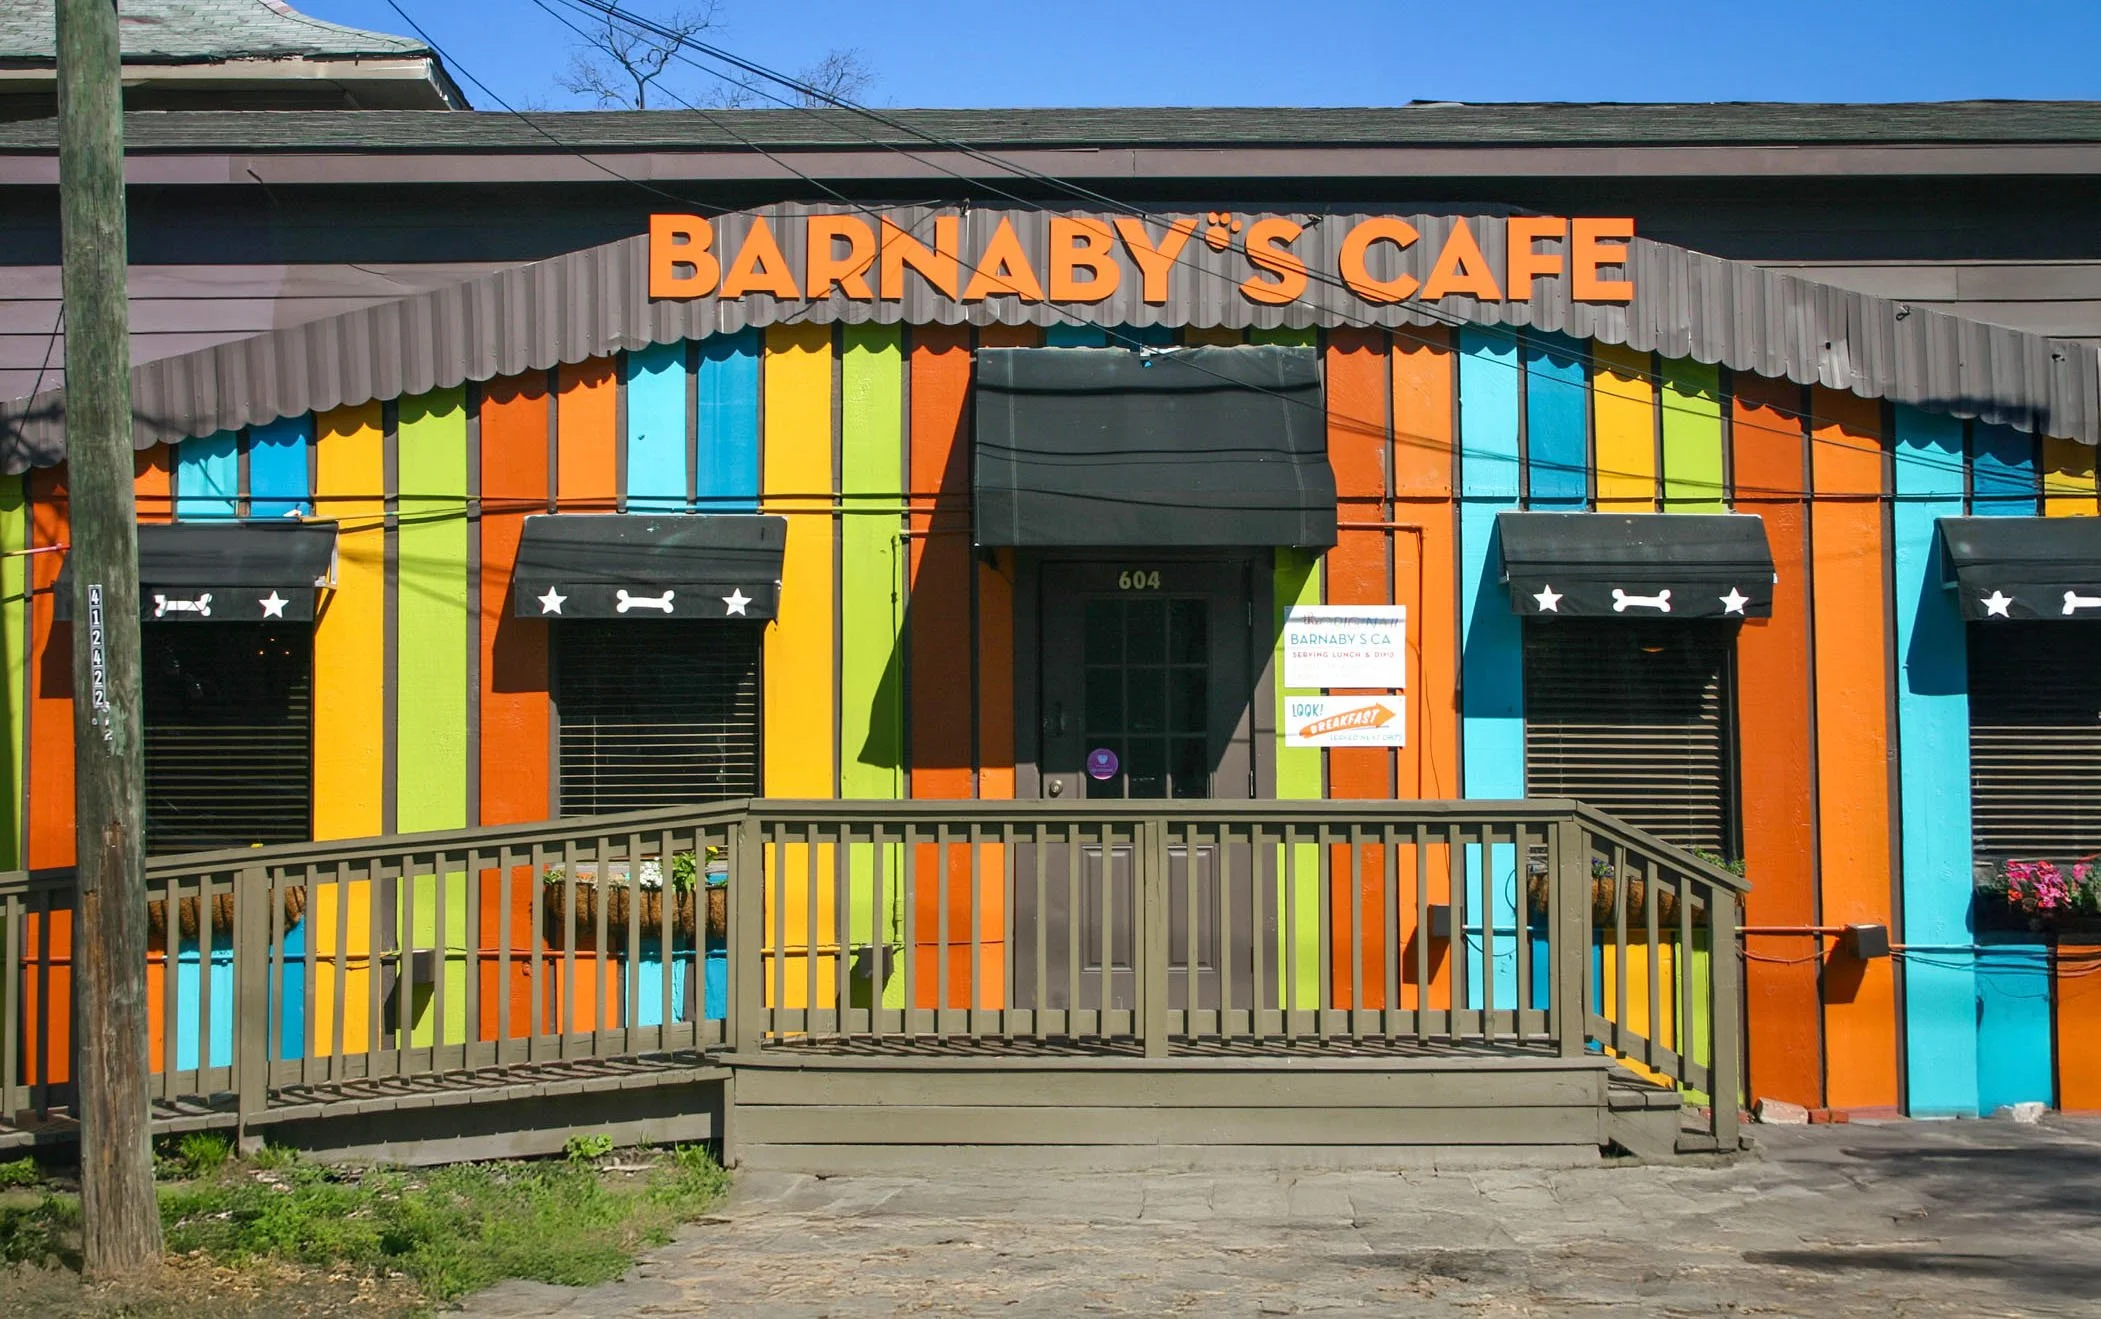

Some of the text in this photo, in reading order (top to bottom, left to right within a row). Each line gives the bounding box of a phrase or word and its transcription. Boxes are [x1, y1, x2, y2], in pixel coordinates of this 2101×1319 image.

[649, 211, 1635, 304] BARNABY'S CAFE
[1118, 570, 1161, 590] 604
[90, 588, 104, 706] 412422
[1292, 703, 1323, 717] LOOK!
[1310, 709, 1380, 734] BREAKFAST
